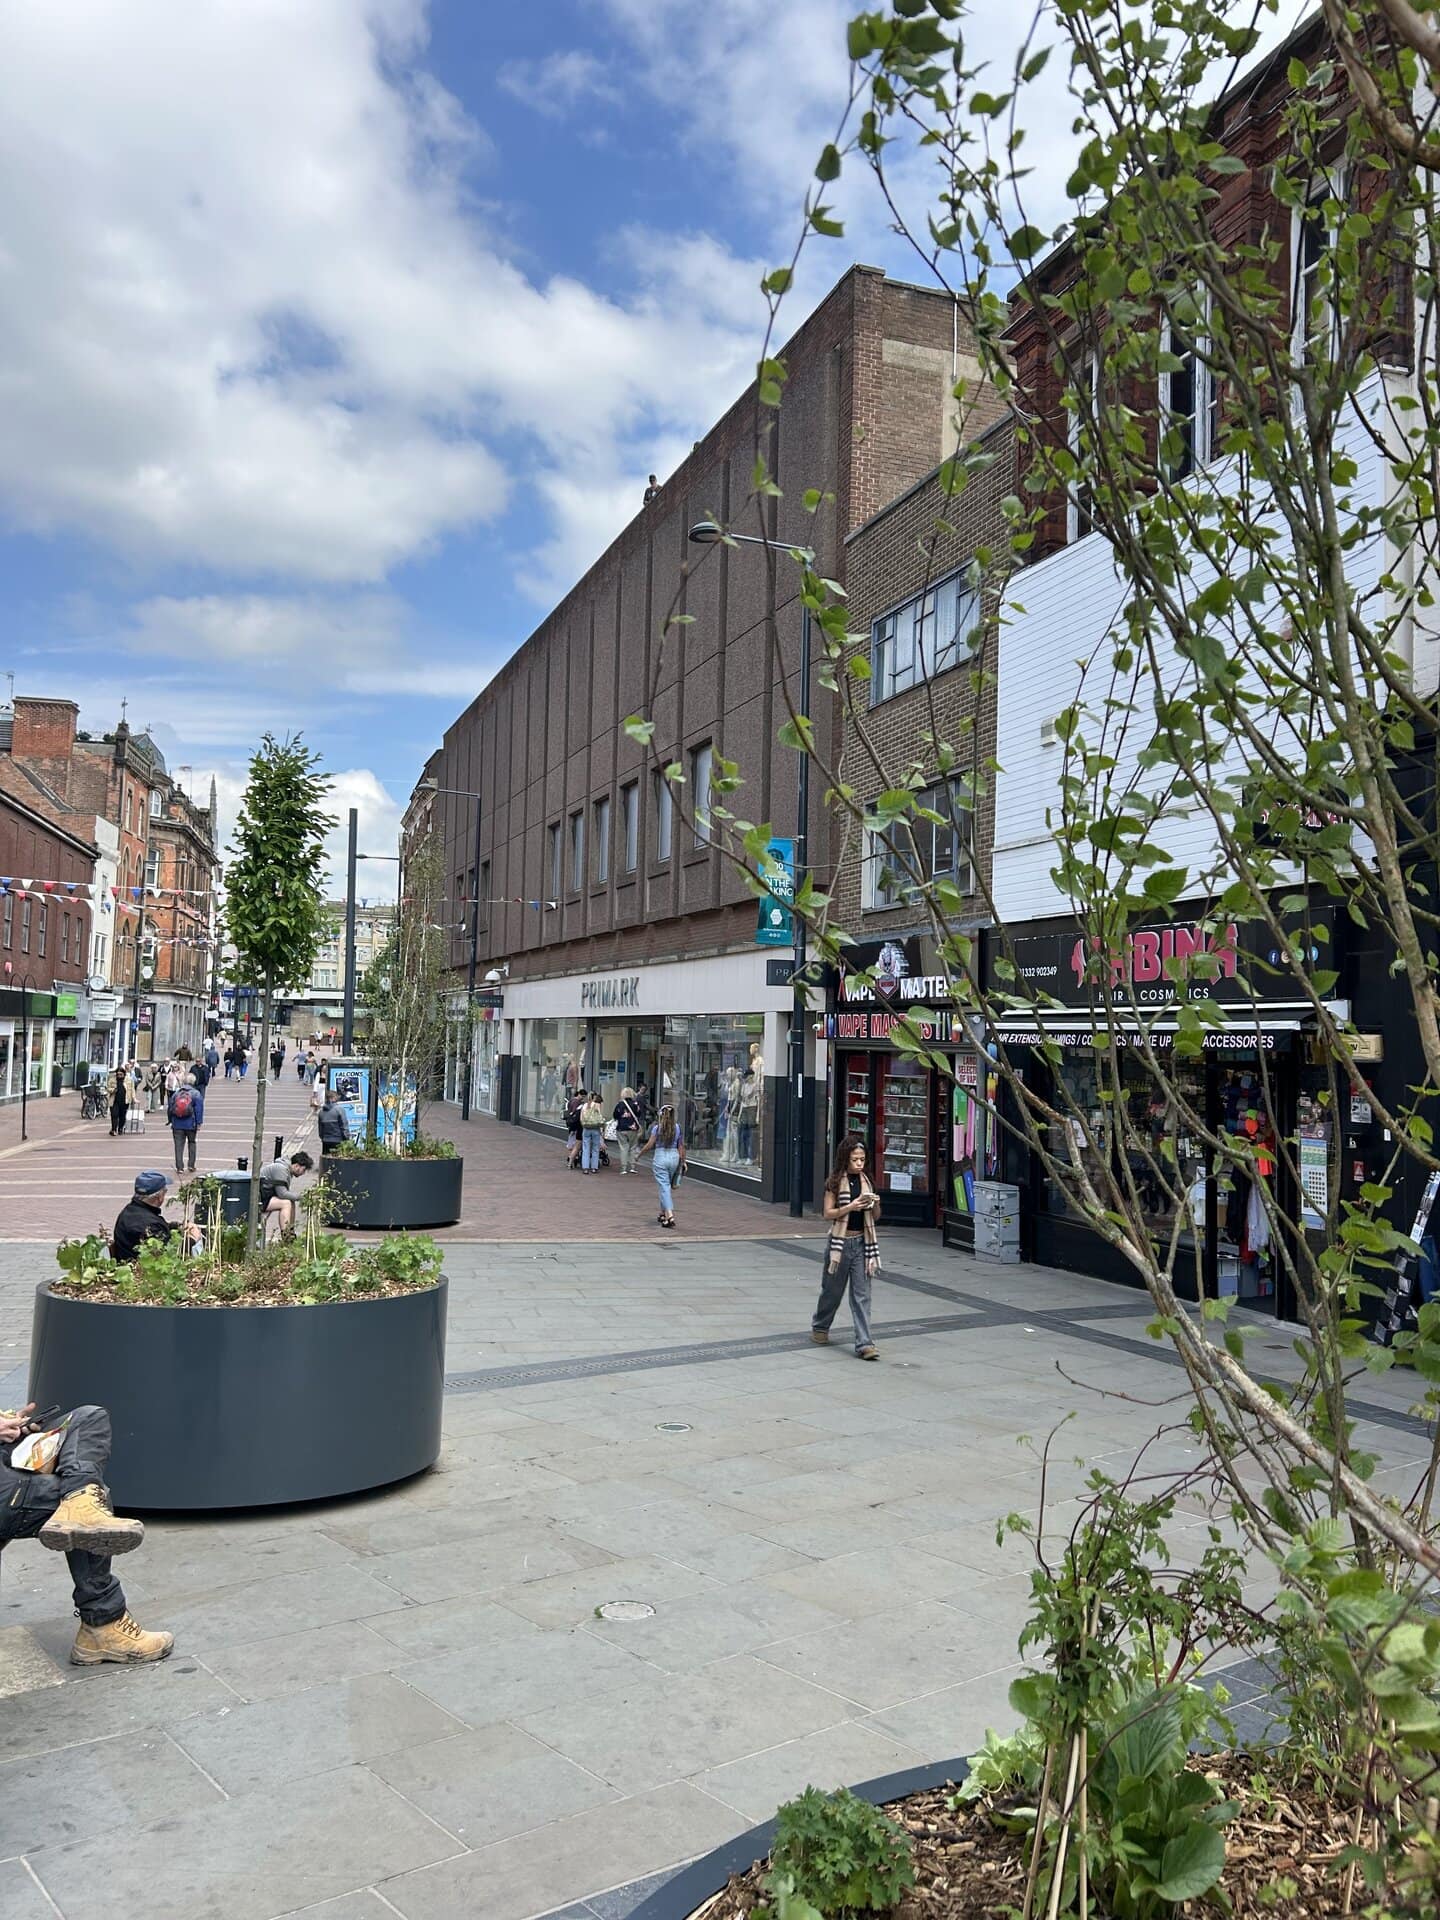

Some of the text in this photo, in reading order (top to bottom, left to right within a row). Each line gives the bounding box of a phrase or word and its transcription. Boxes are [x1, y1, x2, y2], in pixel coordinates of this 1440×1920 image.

[773, 878, 791, 887] THE
[581, 976, 640, 1008] PRIMARK
[1098, 988, 1209, 1001] HIR COSMICS
[838, 1014, 868, 1038] VAPE
[1159, 1035, 1172, 1047] UP
[1202, 1035, 1274, 1048] ACCESSORES
